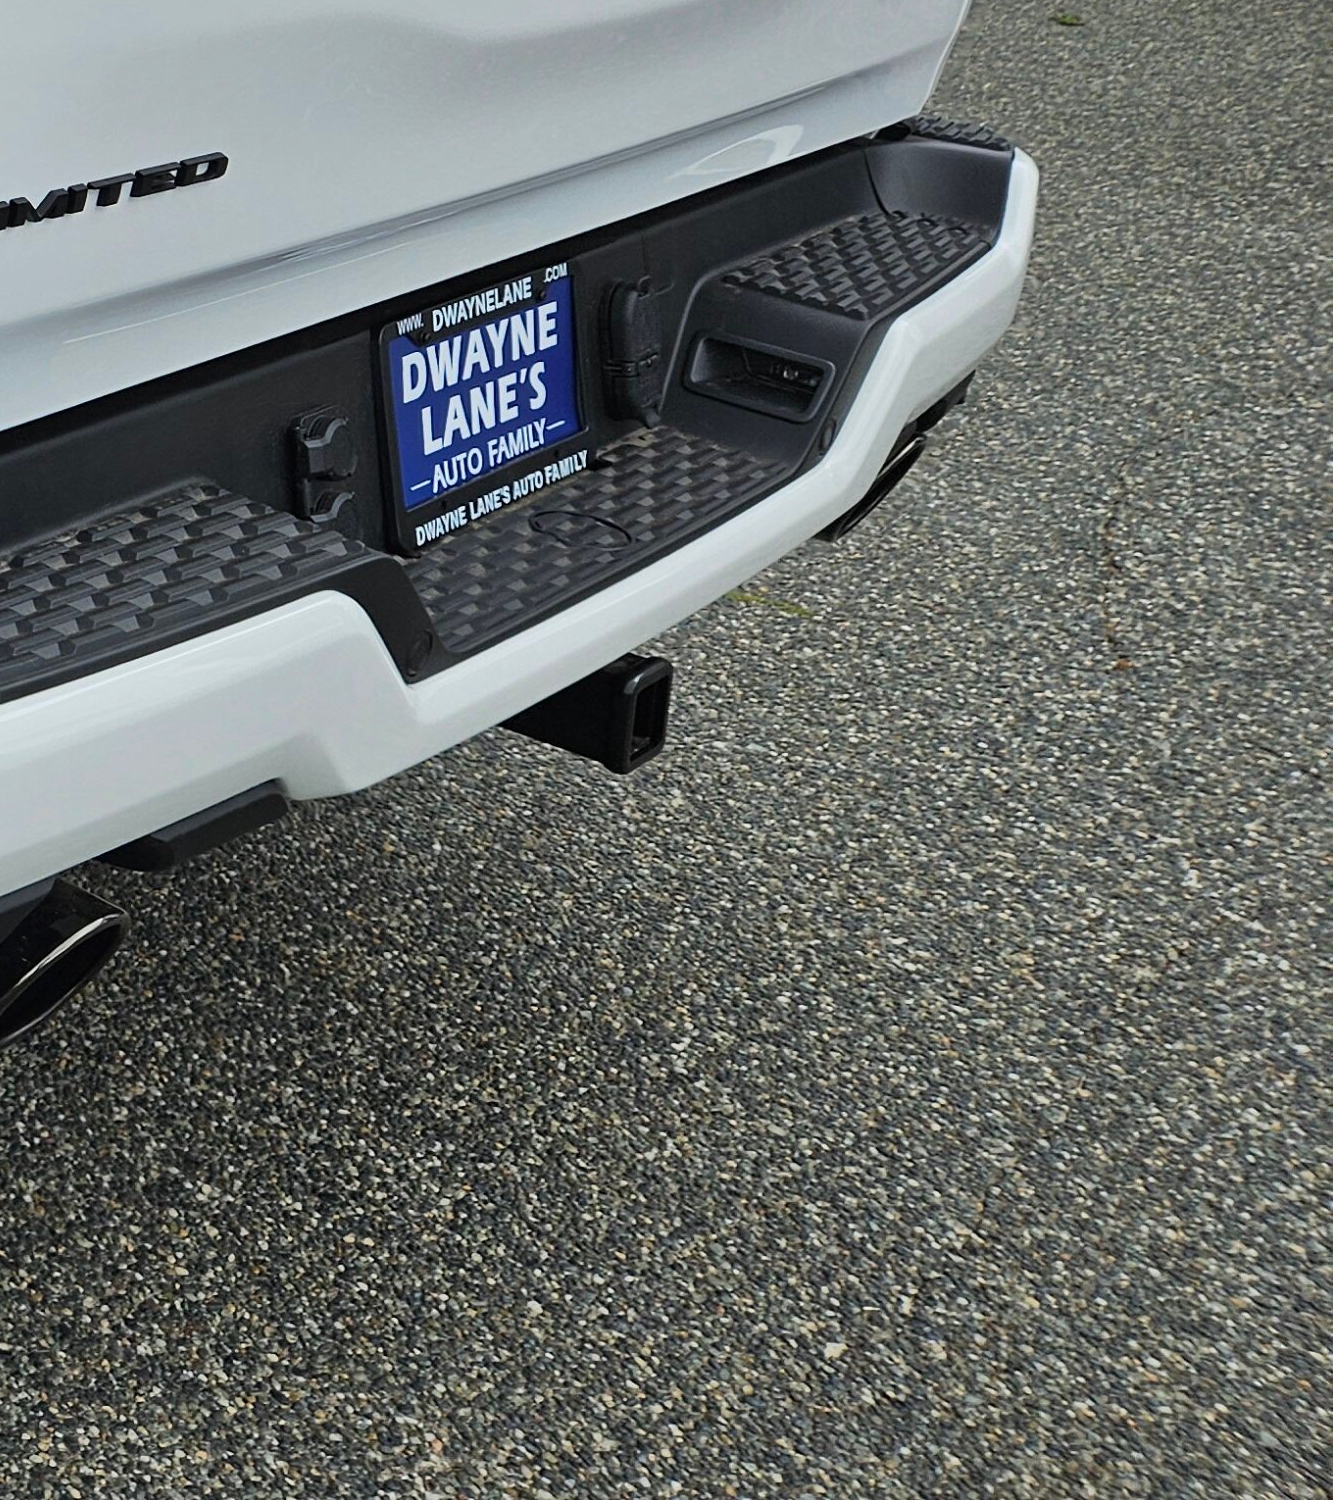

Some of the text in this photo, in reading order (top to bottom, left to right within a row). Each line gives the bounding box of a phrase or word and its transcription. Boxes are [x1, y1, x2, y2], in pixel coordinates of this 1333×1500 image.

[432, 277, 532, 332] DWAYNELANE
[401, 301, 558, 404] DWAYNE
[421, 361, 547, 456] LANE'S
[432, 418, 547, 494] AUTO FAMILY
[415, 449, 589, 547] DWAYNE LANE'S AUTO FAMILY
